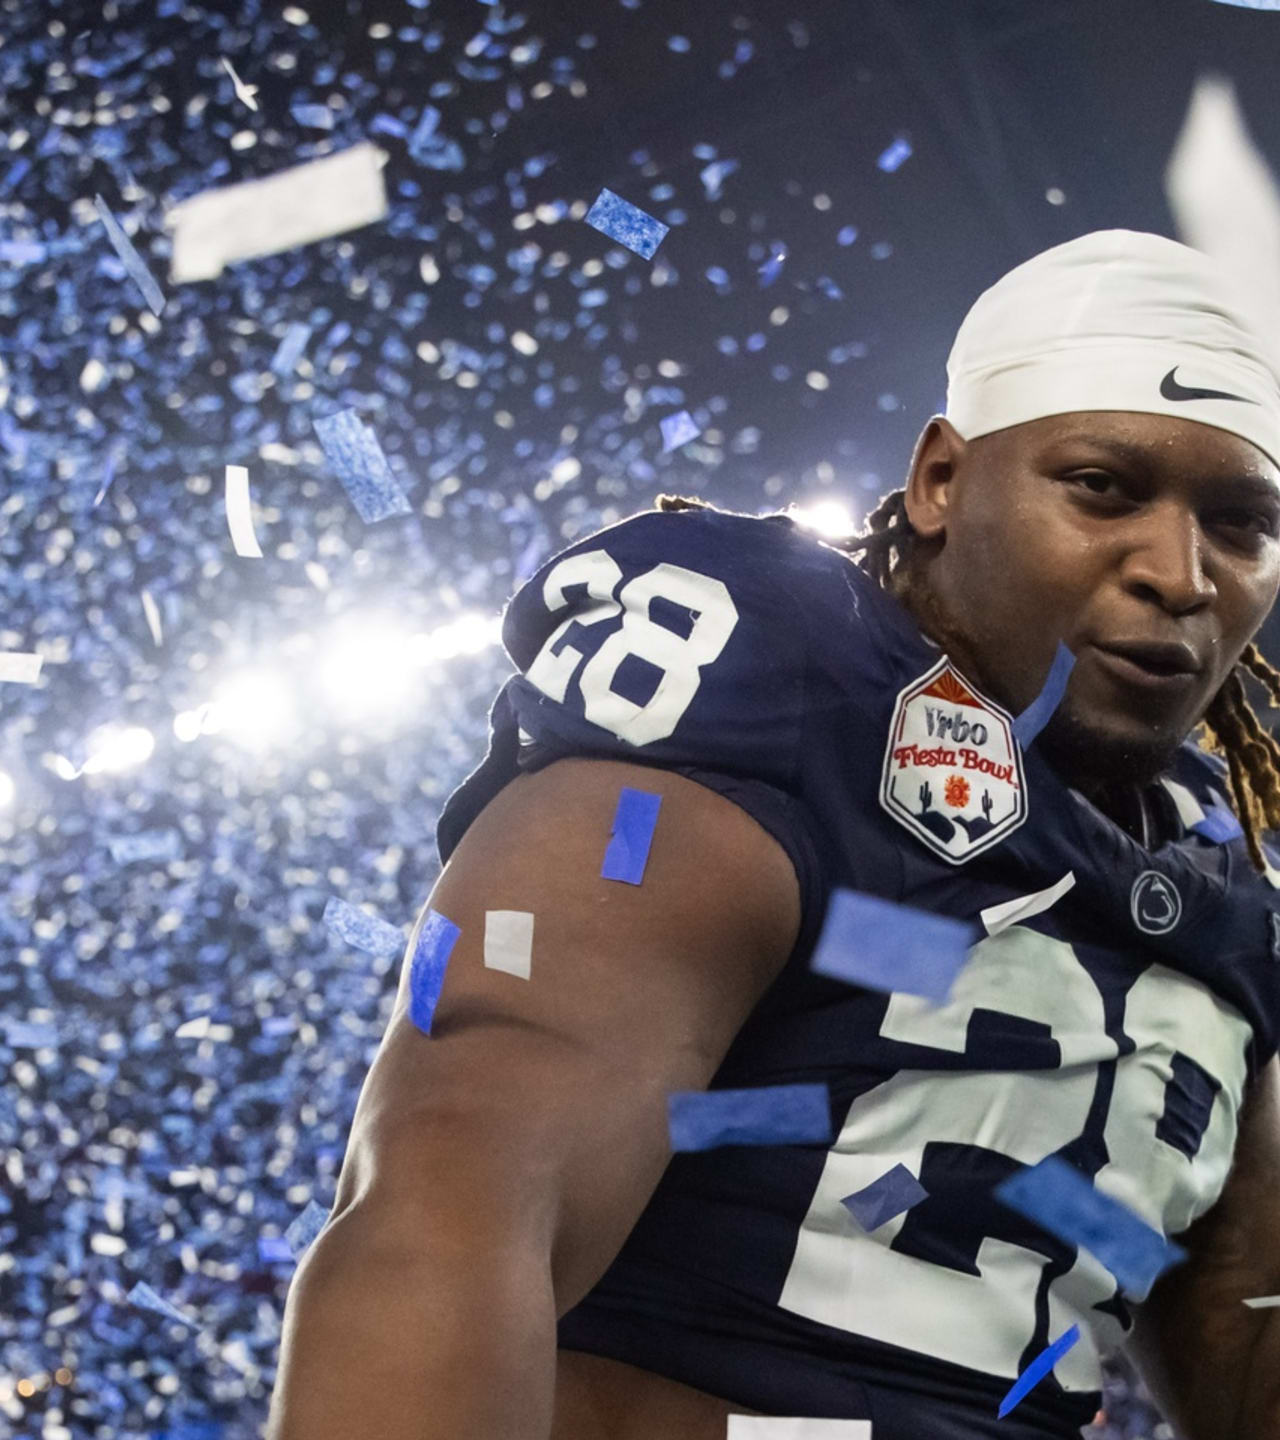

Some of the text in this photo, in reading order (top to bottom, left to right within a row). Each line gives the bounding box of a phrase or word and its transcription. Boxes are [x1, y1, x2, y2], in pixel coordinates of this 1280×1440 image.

[524, 549, 739, 747] 28
[893, 744, 1018, 785] Fiesta Bowl
[924, 706, 988, 746] Vrbo
[778, 924, 1253, 1394] 28
